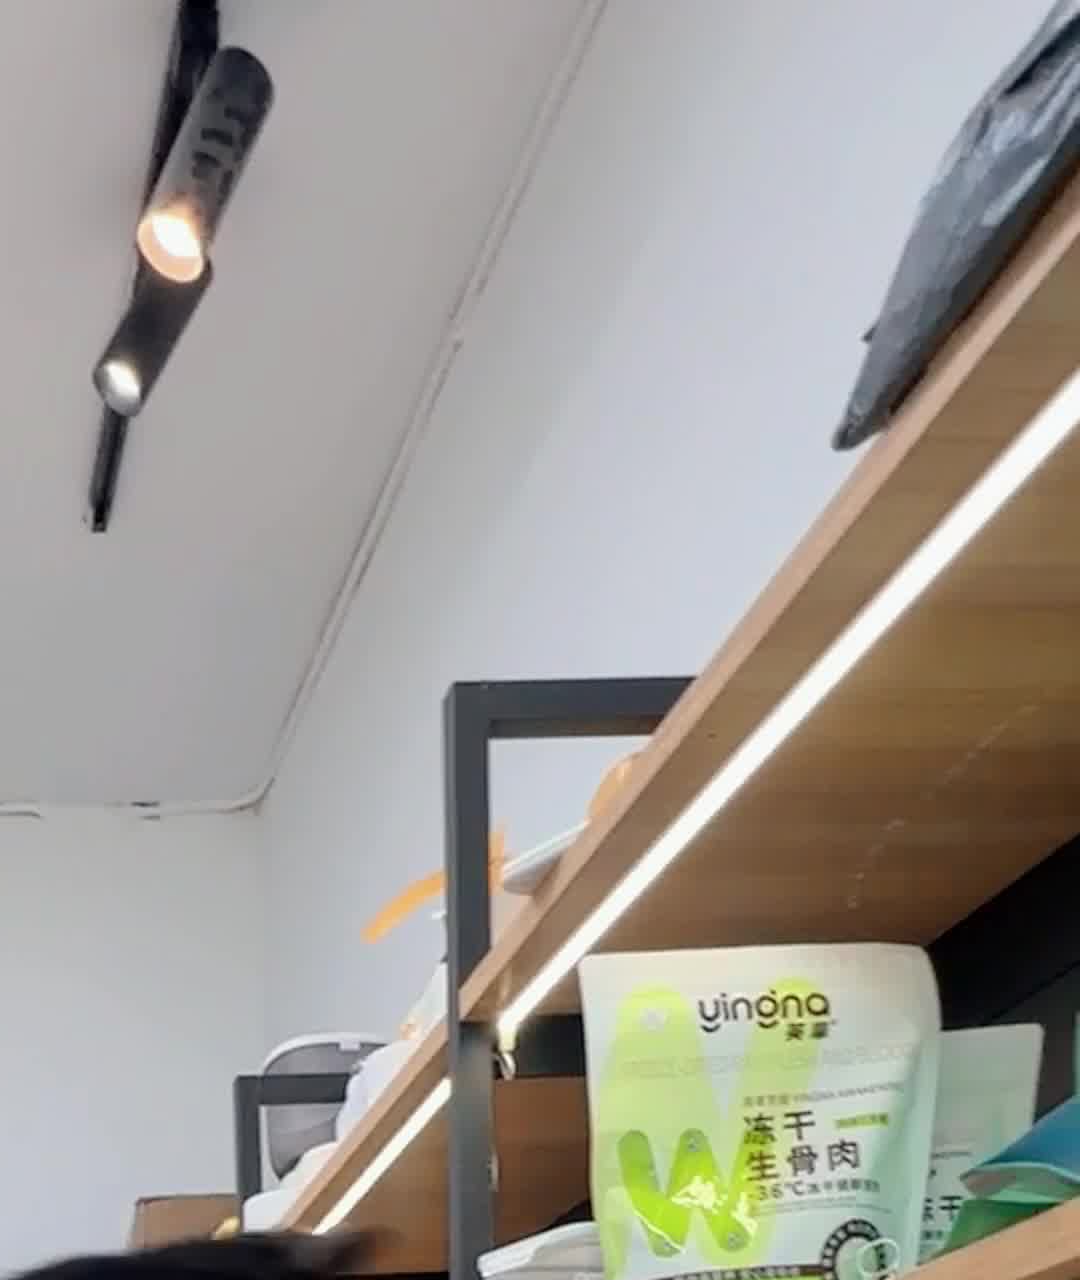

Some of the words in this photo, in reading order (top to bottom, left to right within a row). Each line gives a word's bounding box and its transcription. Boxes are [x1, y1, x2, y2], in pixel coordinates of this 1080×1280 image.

[699, 990, 830, 1033] yingna
[744, 1110, 816, 1145] 冻干
[747, 1139, 860, 1182] 生骨肉
